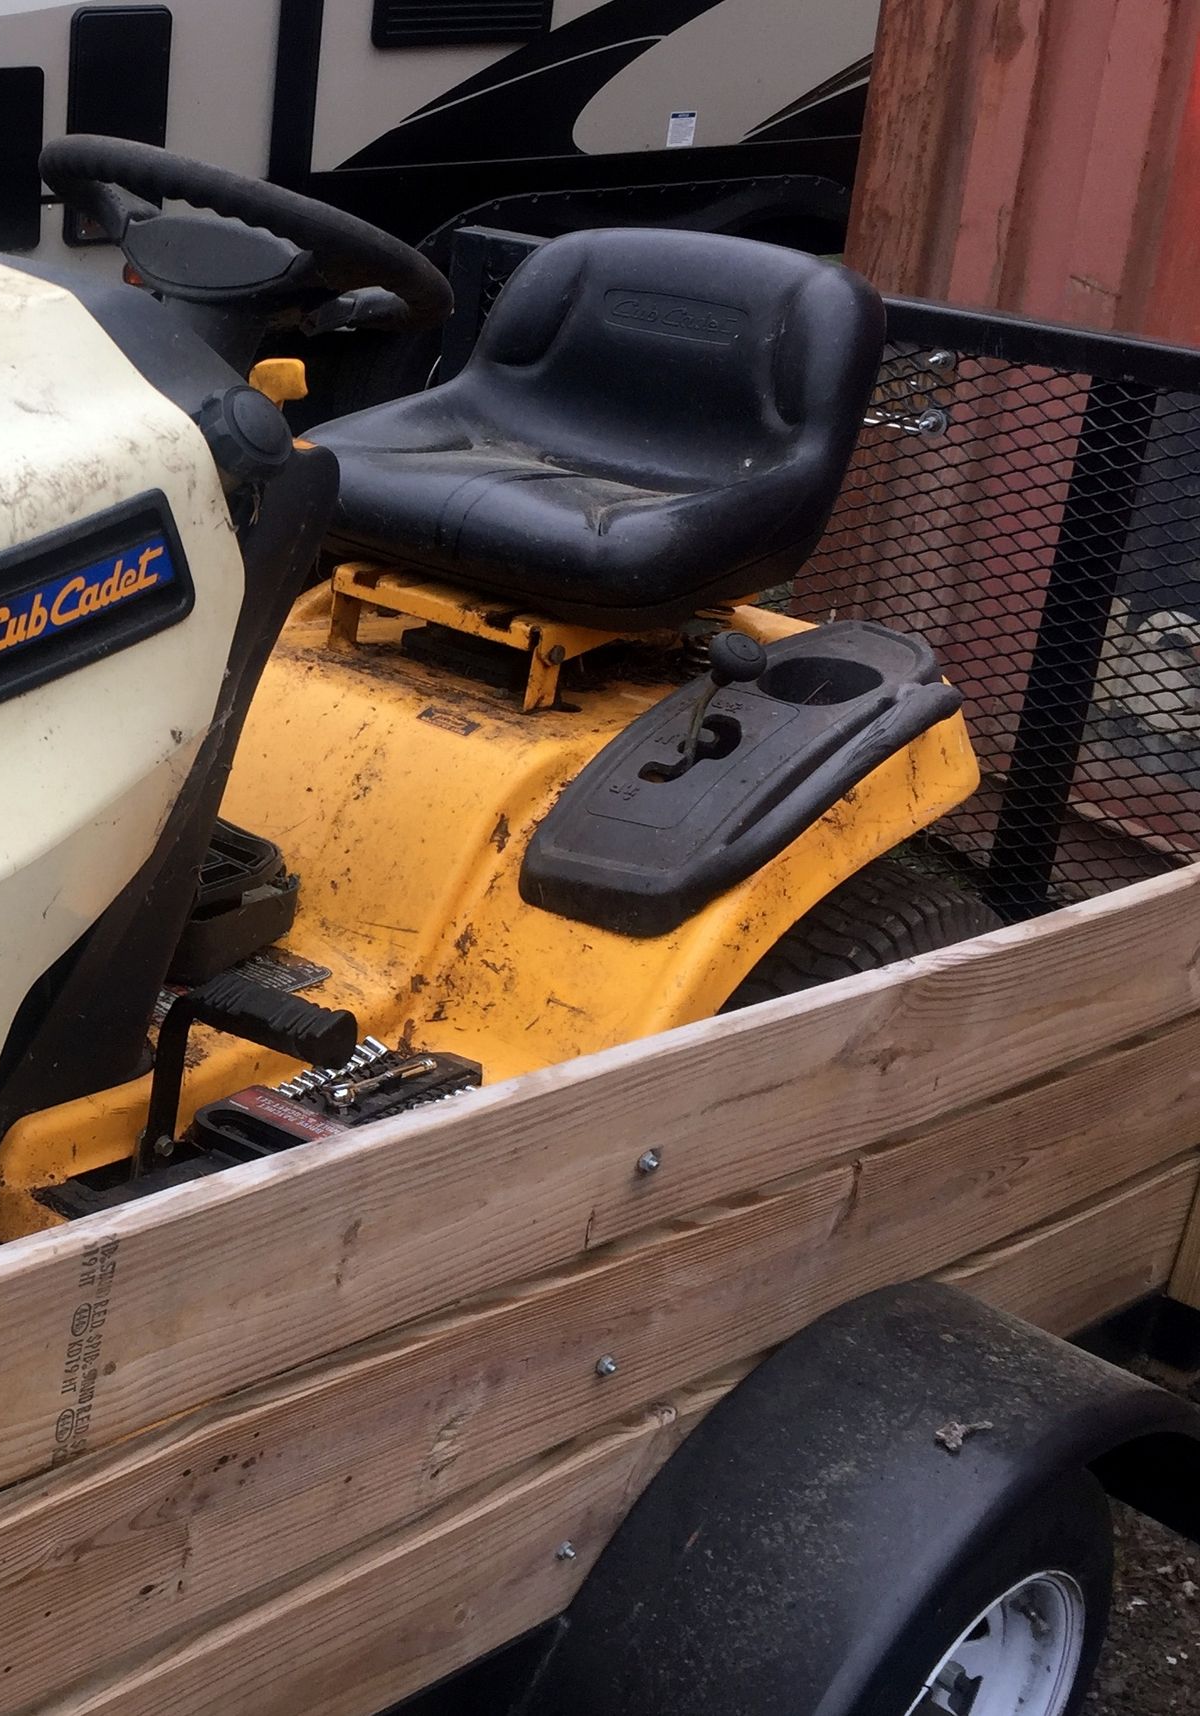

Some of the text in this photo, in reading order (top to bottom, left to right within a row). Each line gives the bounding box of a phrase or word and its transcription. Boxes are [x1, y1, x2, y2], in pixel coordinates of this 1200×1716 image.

[612, 298, 738, 334] Cub Cadet
[50, 546, 164, 626] Cadet
[61, 1376, 79, 1395] HT
